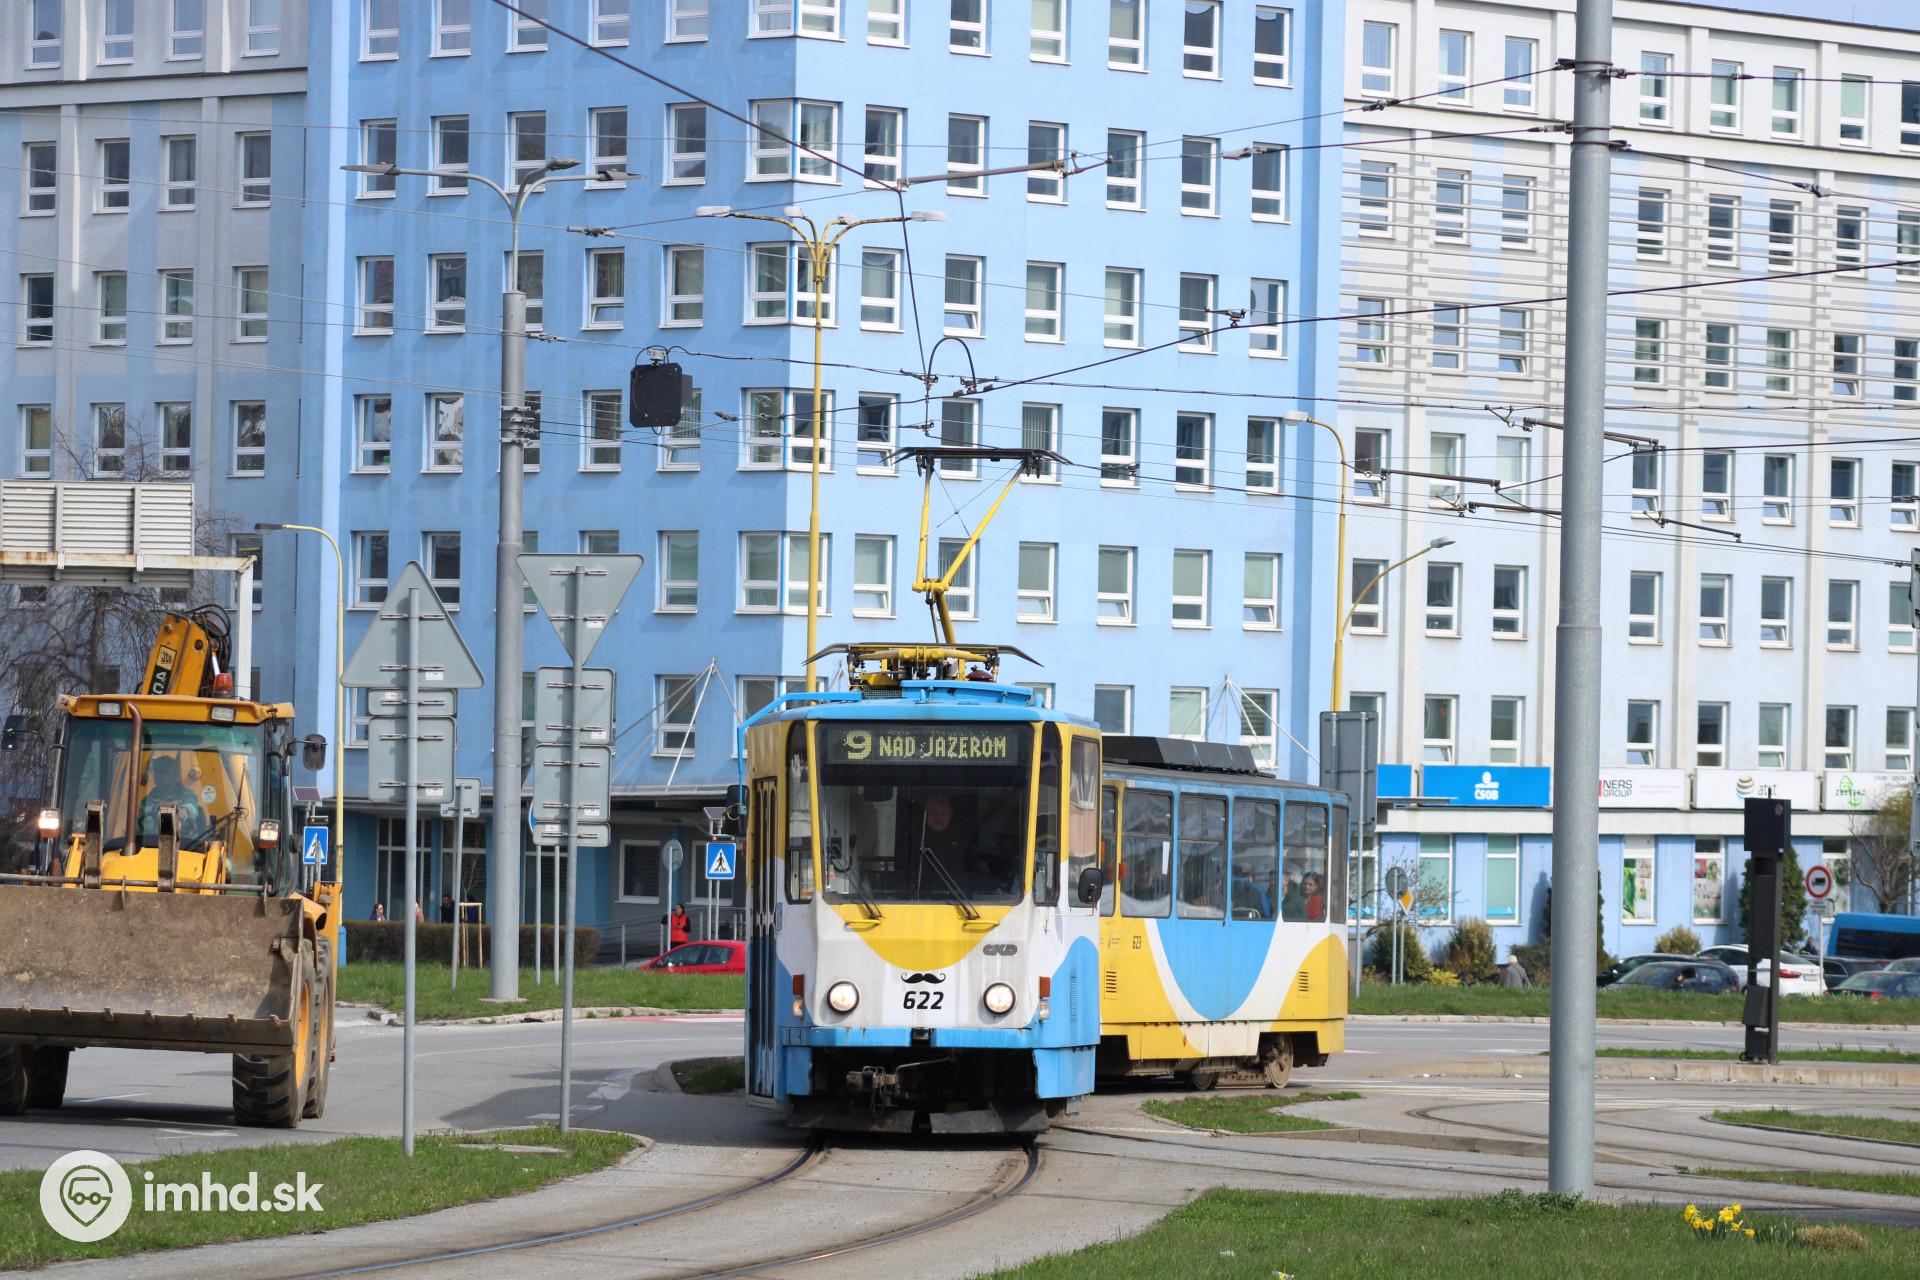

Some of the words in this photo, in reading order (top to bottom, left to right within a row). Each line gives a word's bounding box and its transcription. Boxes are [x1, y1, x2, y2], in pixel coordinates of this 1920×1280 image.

[846, 730, 872, 760] 9
[879, 735, 916, 758] NAD
[920, 735, 1006, 759] JAZEROM
[1602, 779, 1633, 789] NERS
[1602, 789, 1633, 798] GROUP
[903, 990, 944, 1010] 622
